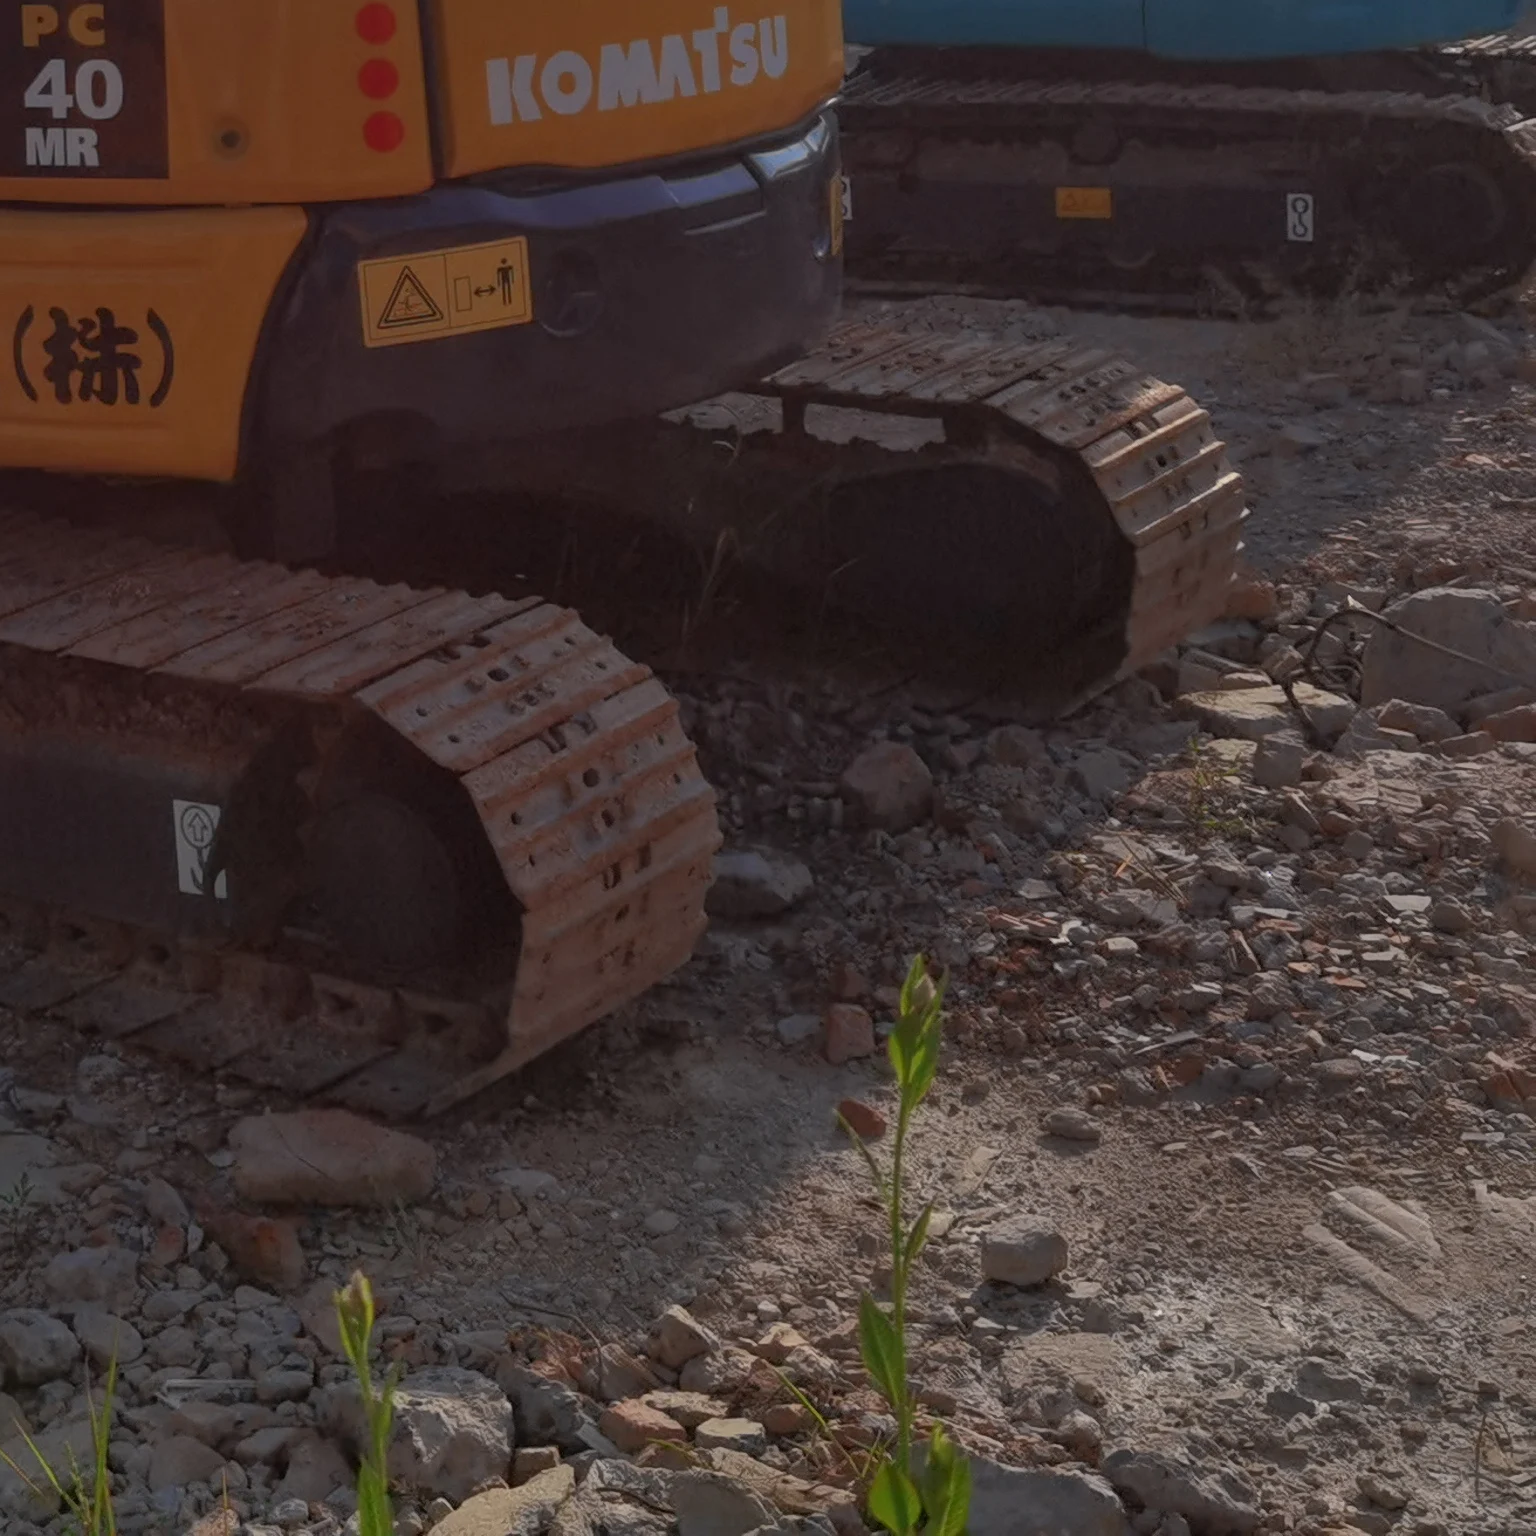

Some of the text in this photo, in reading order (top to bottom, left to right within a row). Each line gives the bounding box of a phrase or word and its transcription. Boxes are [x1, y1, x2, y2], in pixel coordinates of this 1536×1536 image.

[21, 3, 105, 48] PC
[24, 58, 124, 120] 40
[485, 5, 789, 126] KOMATSU
[25, 127, 99, 167] MR
